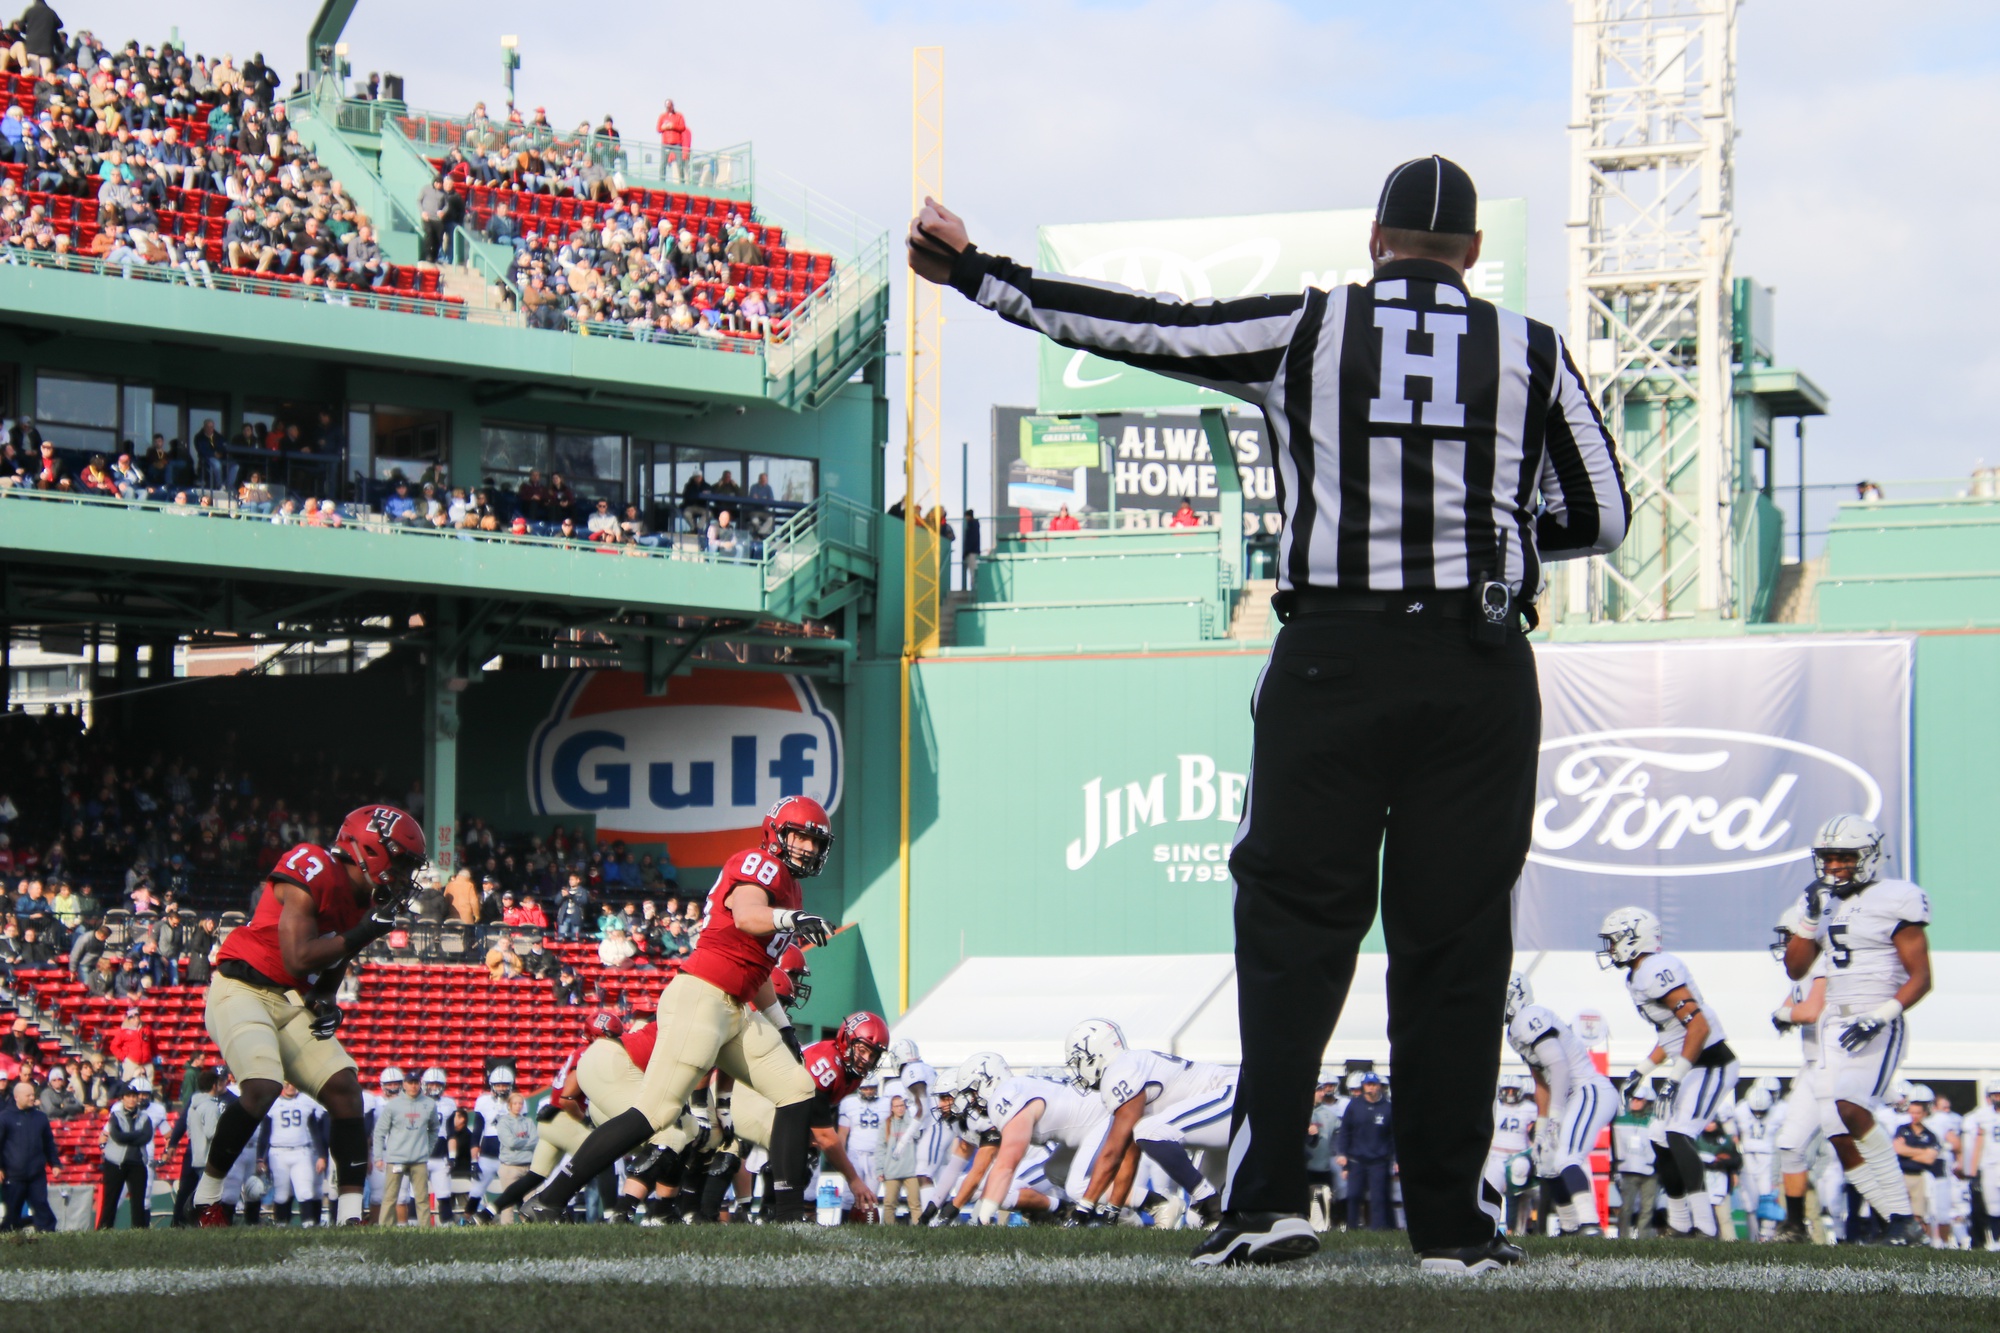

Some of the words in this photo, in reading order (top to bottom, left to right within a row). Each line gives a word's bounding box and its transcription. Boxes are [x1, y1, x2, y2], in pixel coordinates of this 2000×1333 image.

[1369, 307, 1467, 427] H
[1119, 425, 1259, 463] ALWAS
[1114, 461, 1219, 497] HOME
[552, 730, 818, 810] Gulf
[1533, 746, 1799, 851] Ford
[366, 807, 402, 837] H
[438, 826, 452, 843] 32
[1066, 773, 1168, 870] JIM
[286, 847, 324, 882] 13
[438, 851, 451, 867] 33
[740, 853, 779, 886] 88
[1166, 864, 1229, 882] 1795
[1827, 924, 1853, 969] 5
[1655, 968, 1676, 988] 30
[1073, 1034, 1097, 1063] Y
[810, 1057, 837, 1088] 58
[1111, 1080, 1134, 1103] 92
[280, 1109, 302, 1128] 59
[994, 1097, 1014, 1118] 24
[1499, 1117, 1520, 1131] 42
